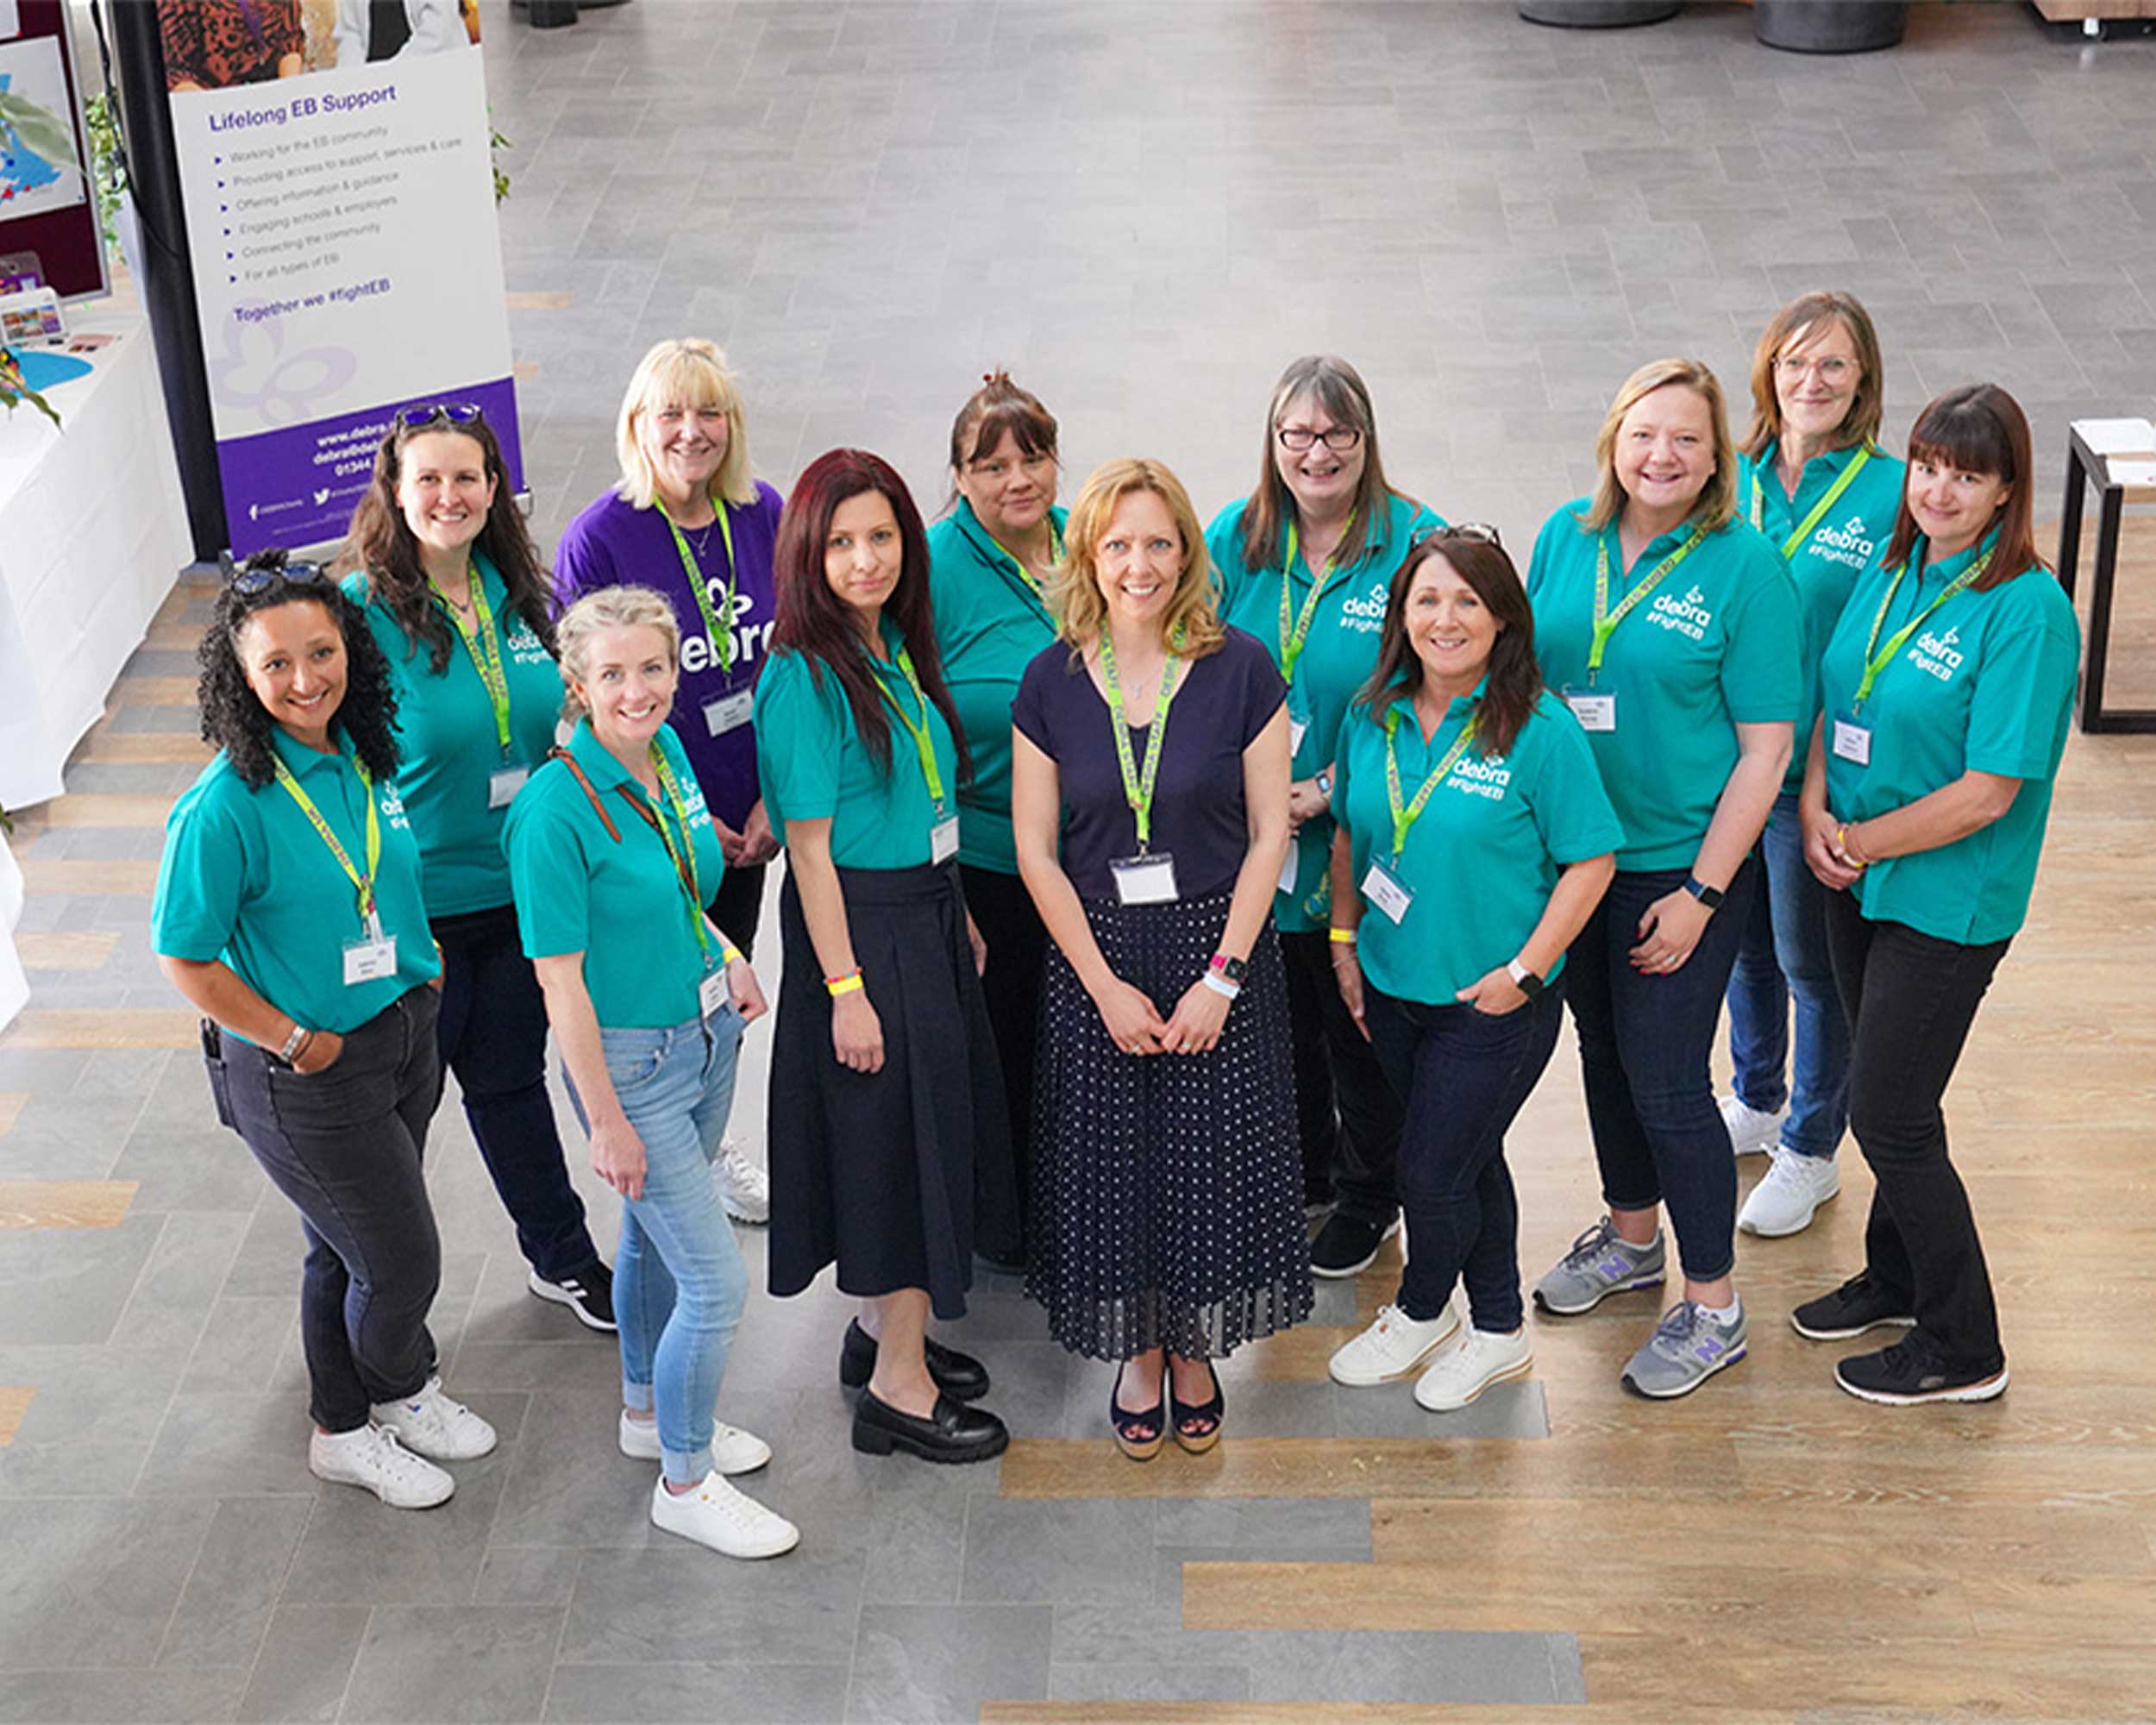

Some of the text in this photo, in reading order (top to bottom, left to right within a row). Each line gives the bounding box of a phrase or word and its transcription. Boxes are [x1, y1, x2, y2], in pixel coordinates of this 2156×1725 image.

[209, 85, 397, 132] Lifelong EB Support
[229, 125, 388, 162] Working for the EB community
[233, 169, 284, 185] Providing
[286, 162, 323, 177] access
[324, 159, 336, 170] to
[384, 143, 428, 159] services
[430, 140, 438, 151] &
[440, 137, 462, 150] care
[235, 196, 279, 211] Offering
[282, 183, 340, 201] information
[353, 172, 399, 191] guidance
[239, 217, 290, 235] Engaging
[292, 209, 331, 224] schools
[344, 195, 398, 213] employers
[241, 223, 380, 259] Connecting the community
[245, 252, 341, 280] For all types of EB
[234, 278, 391, 323] Together we #fightEB
[334, 456, 372, 477] 01344
[1808, 543, 1867, 570] #fightEB
[1814, 526, 1875, 556] debra
[1342, 597, 1388, 618] debr
[1652, 593, 1712, 627] debra
[1645, 611, 1704, 641] #fightEB
[680, 620, 775, 674] ebr
[1916, 630, 1965, 668] debra
[1907, 648, 1953, 681] #fightEB
[1446, 775, 1505, 801] #fightEB
[1452, 757, 1512, 787] debra
[1598, 1254, 1633, 1282] N
[1695, 1336, 1725, 1364] N
